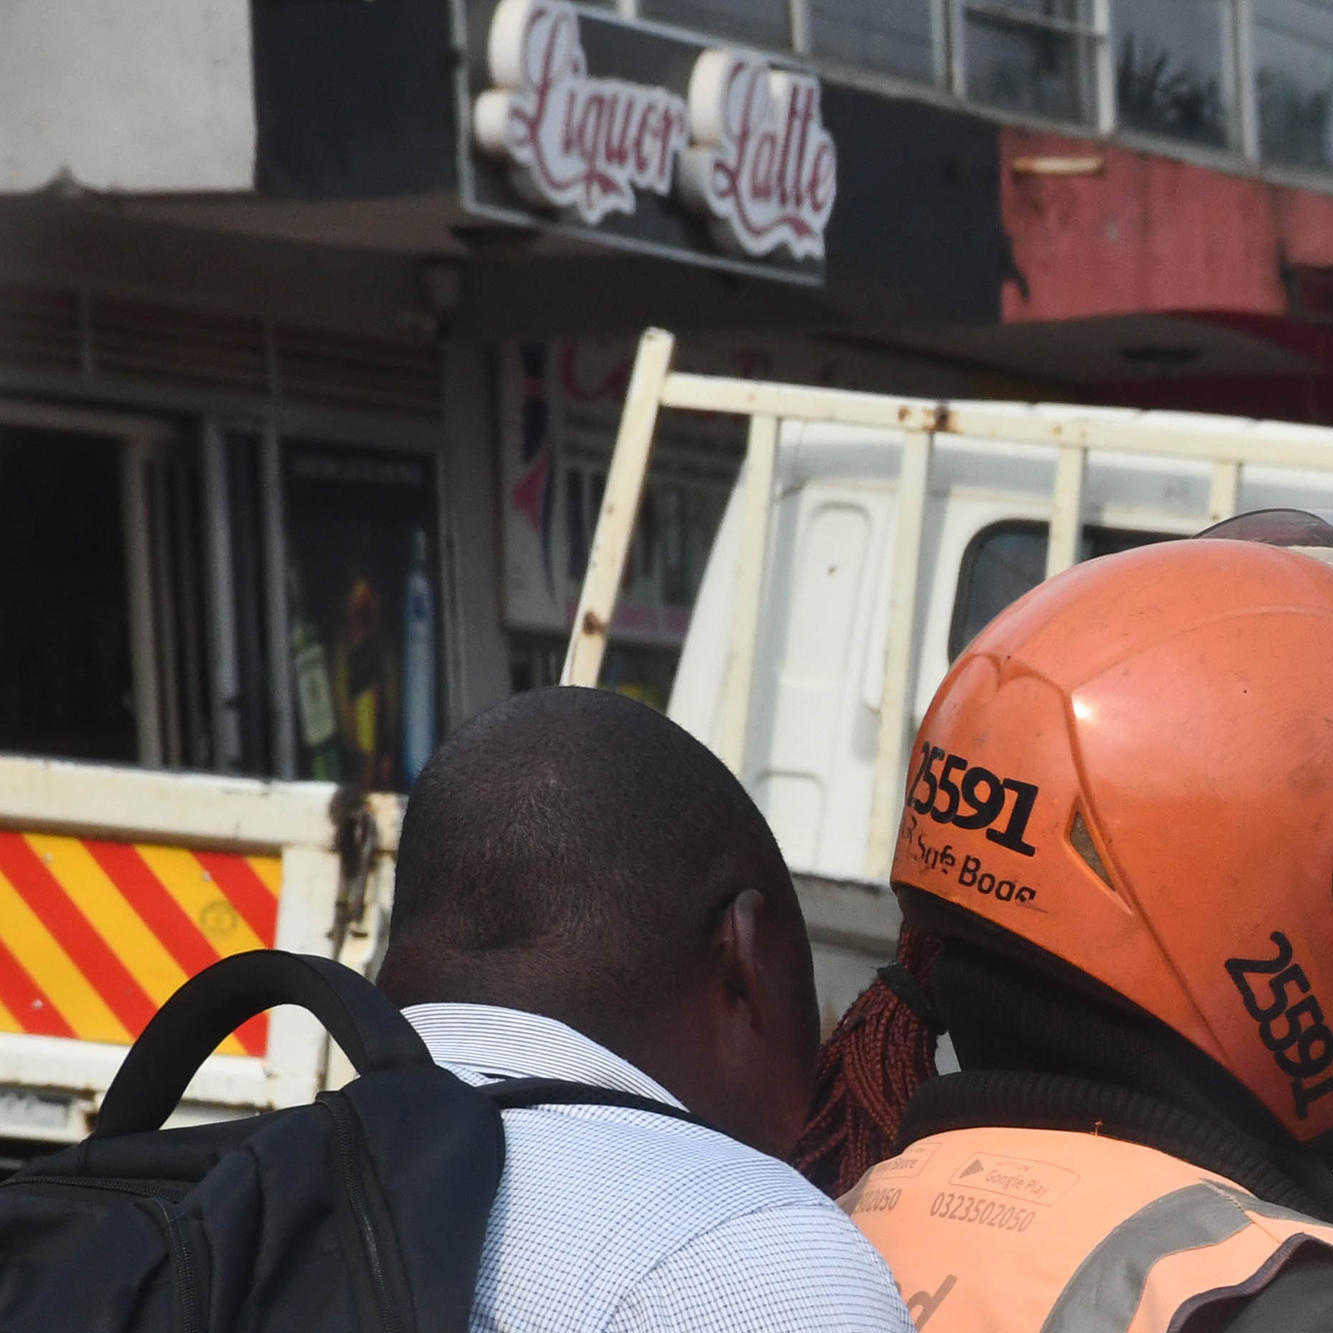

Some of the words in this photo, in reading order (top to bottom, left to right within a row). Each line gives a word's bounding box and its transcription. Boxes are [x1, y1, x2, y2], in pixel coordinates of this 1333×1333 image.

[507, 5, 684, 208] Liquor
[712, 58, 837, 238] Latte
[929, 1191, 1037, 1233] 0323502050
